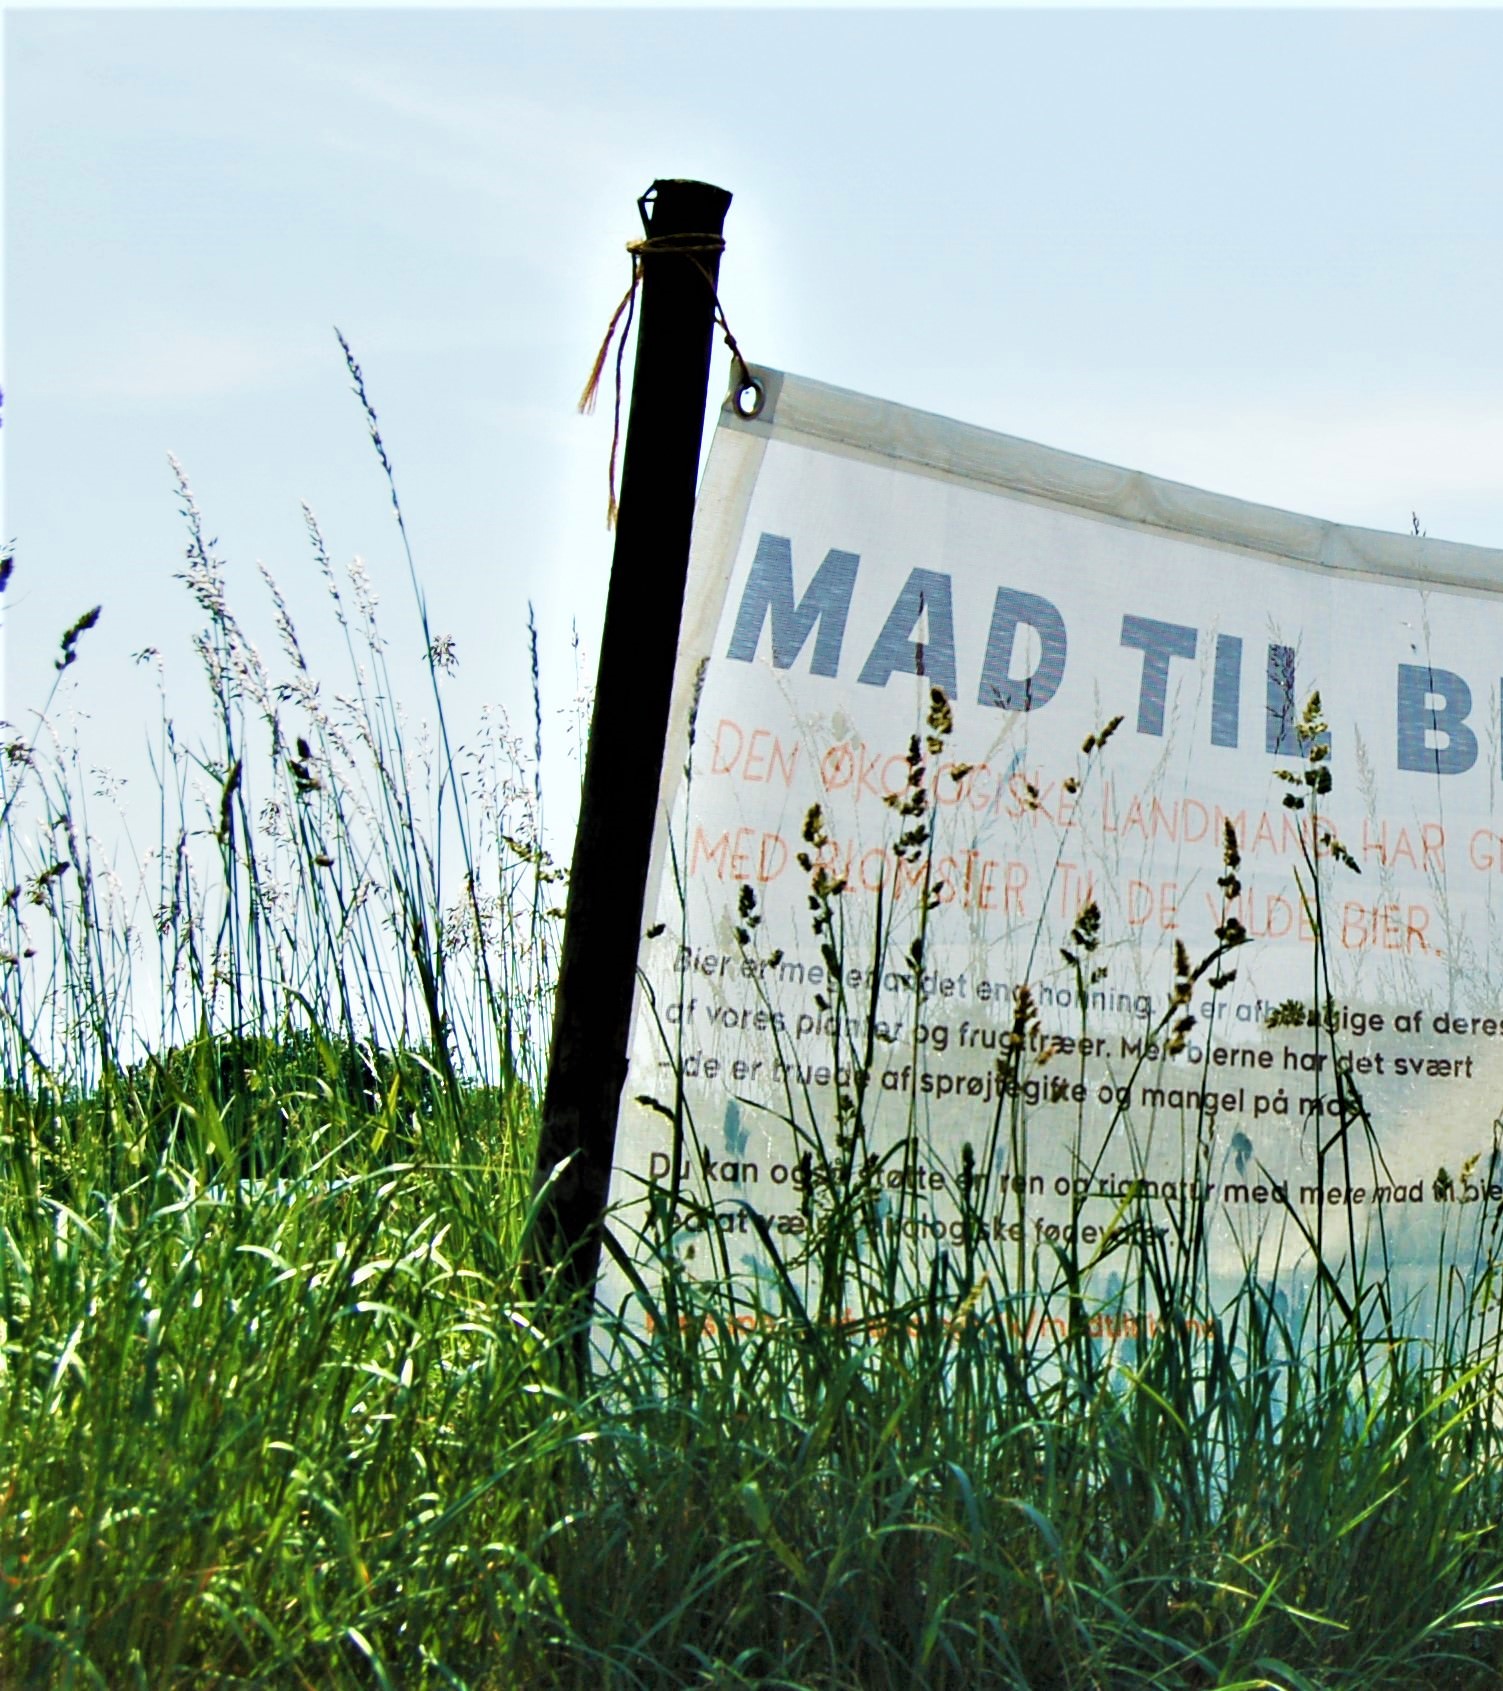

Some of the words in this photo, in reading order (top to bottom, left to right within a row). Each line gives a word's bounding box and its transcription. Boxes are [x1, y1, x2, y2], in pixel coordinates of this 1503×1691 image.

[726, 531, 1068, 713] MAD
[1120, 612, 1333, 762] TIL
[710, 718, 800, 787] DEN
[1362, 816, 1446, 874] HAR
[690, 825, 788, 884] MED
[1127, 879, 1180, 930] DE
[1341, 901, 1442, 958] BIER.
[706, 1005, 786, 1032] vores
[959, 1020, 1112, 1059] frugtræer.
[1283, 1045, 1328, 1072] har
[1394, 1055, 1473, 1079] svært
[1394, 1010, 1423, 1033] af
[684, 1050, 720, 1079] de
[732, 1058, 763, 1081] er
[881, 1065, 911, 1092] af
[1097, 1083, 1131, 1112] og
[1142, 1087, 1244, 1117] mangel
[1254, 1087, 1289, 1119] på
[650, 1152, 690, 1180] Du
[1223, 1179, 1289, 1204] med
[1370, 1180, 1424, 1204] mad
